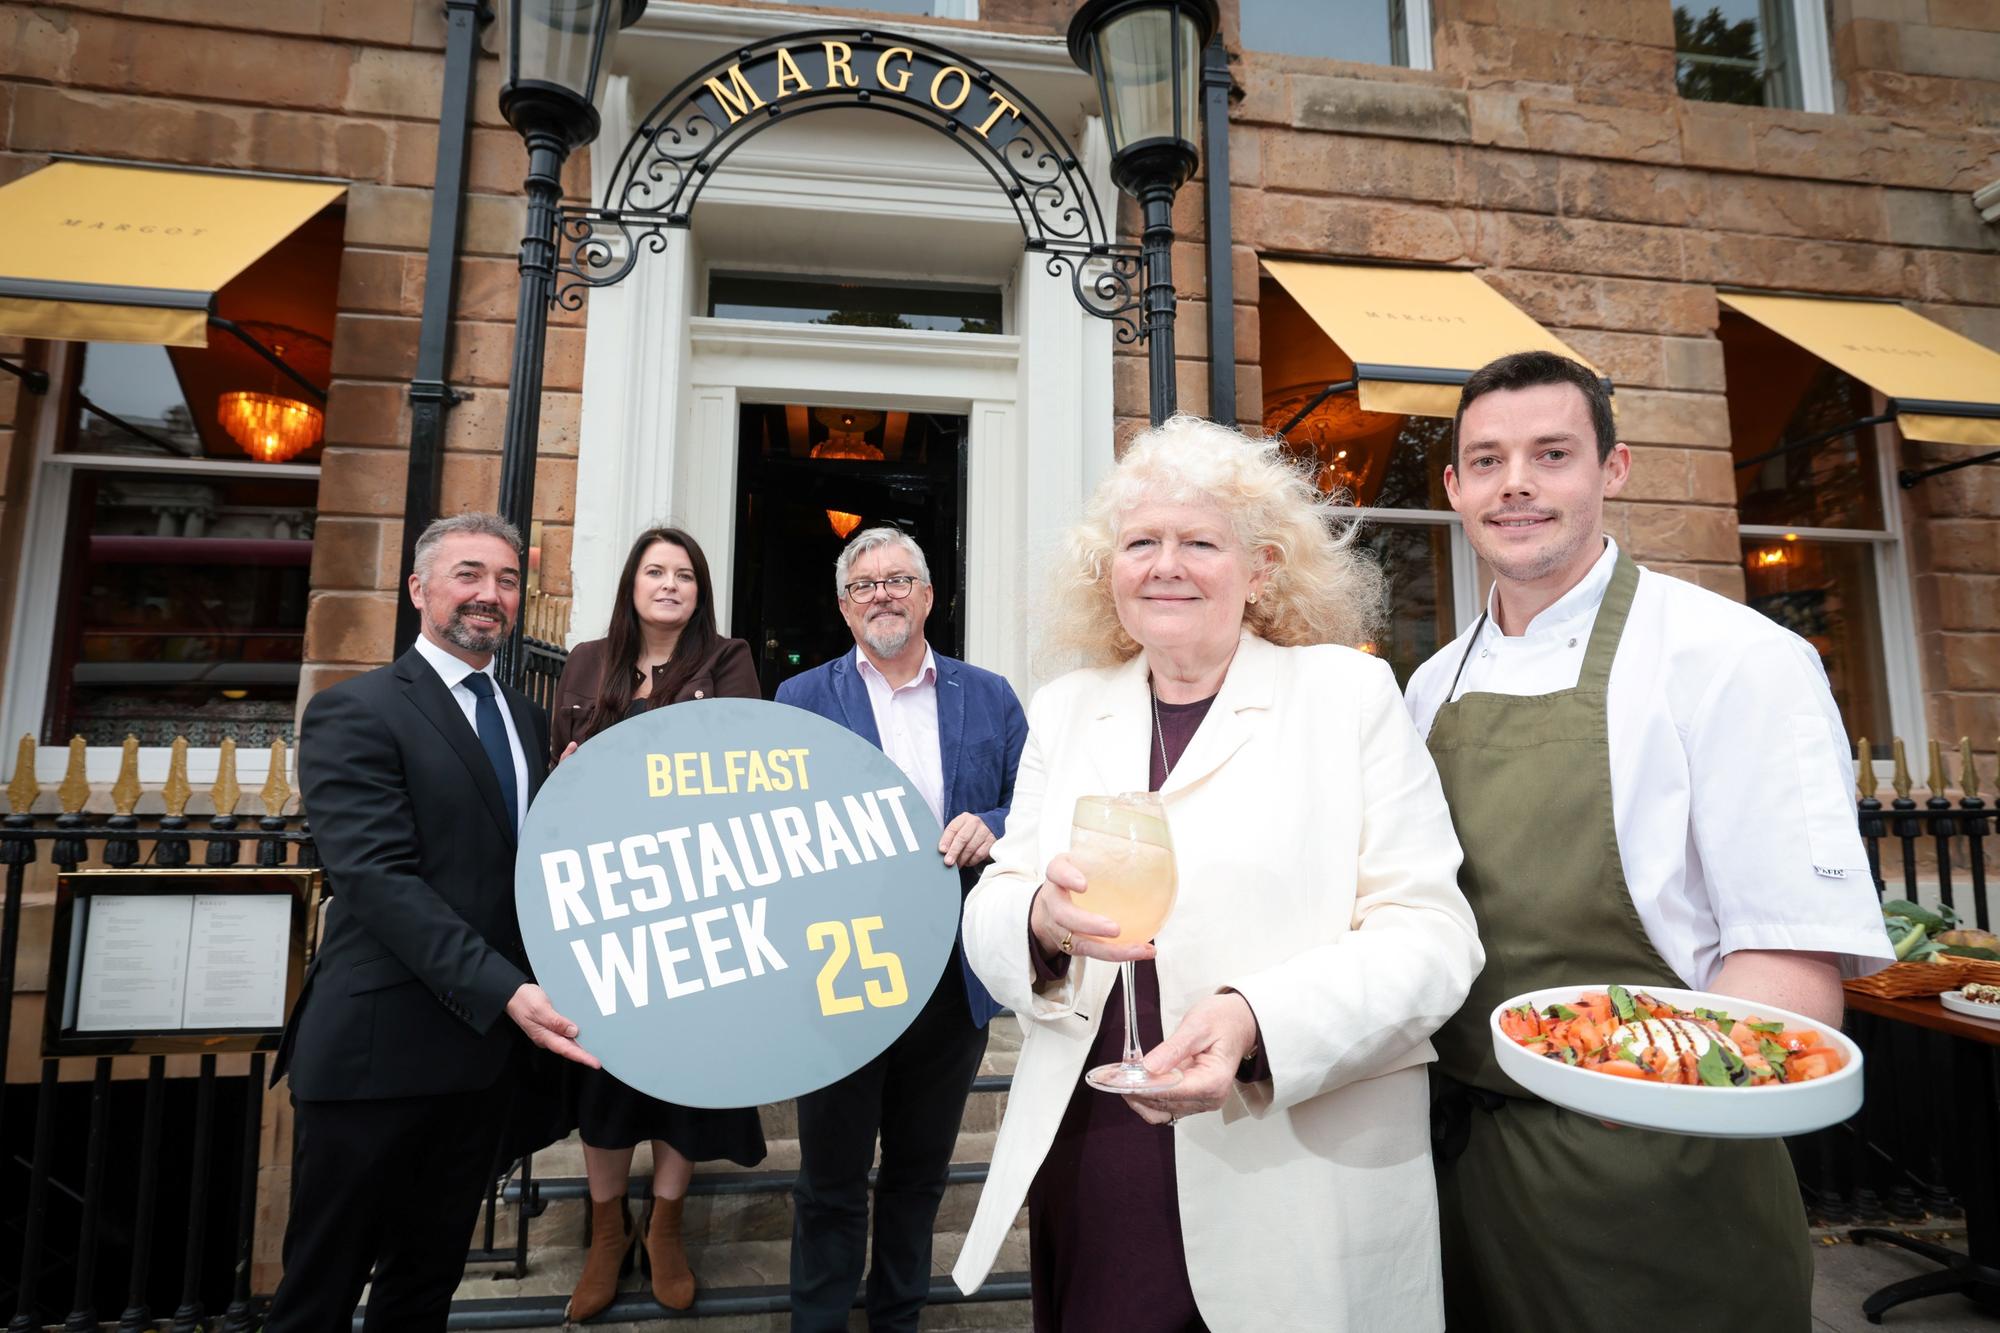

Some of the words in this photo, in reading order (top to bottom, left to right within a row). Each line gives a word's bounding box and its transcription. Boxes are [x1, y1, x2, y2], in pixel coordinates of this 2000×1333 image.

[703, 40, 1021, 139] MARGOT
[59, 219, 208, 236] MARGOT
[1364, 311, 1467, 324] MARGOT
[646, 748, 810, 798] BELFAST
[540, 786, 920, 931] RESTAURANT
[569, 897, 789, 1017] WEEK
[805, 915, 909, 1017] 25
